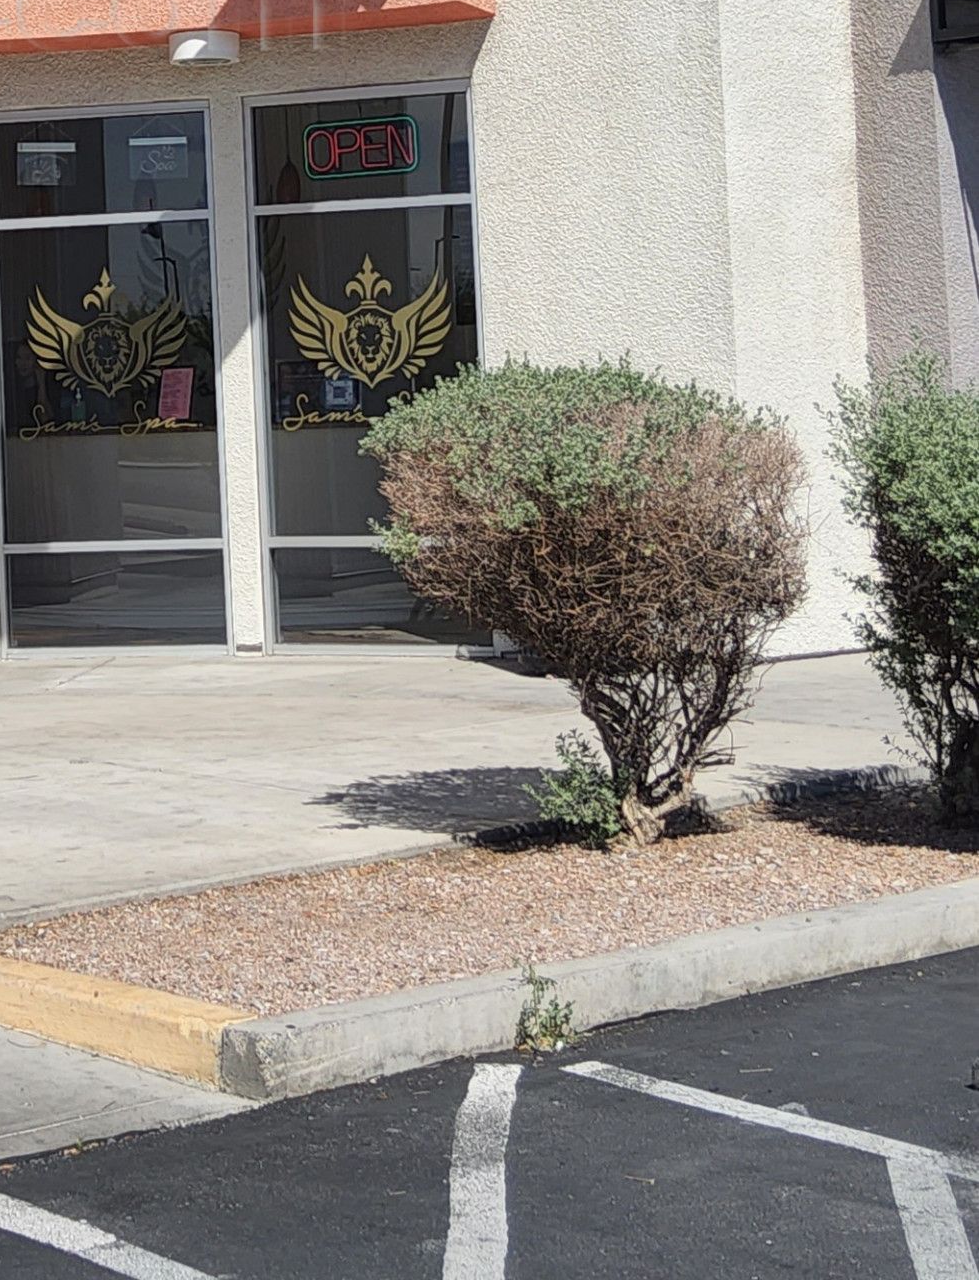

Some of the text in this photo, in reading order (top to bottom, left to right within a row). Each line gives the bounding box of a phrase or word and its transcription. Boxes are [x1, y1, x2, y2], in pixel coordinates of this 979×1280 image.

[308, 124, 414, 172] OPEN
[20, 400, 202, 440] Sam's Spa
[273, 393, 383, 432] Sam's
